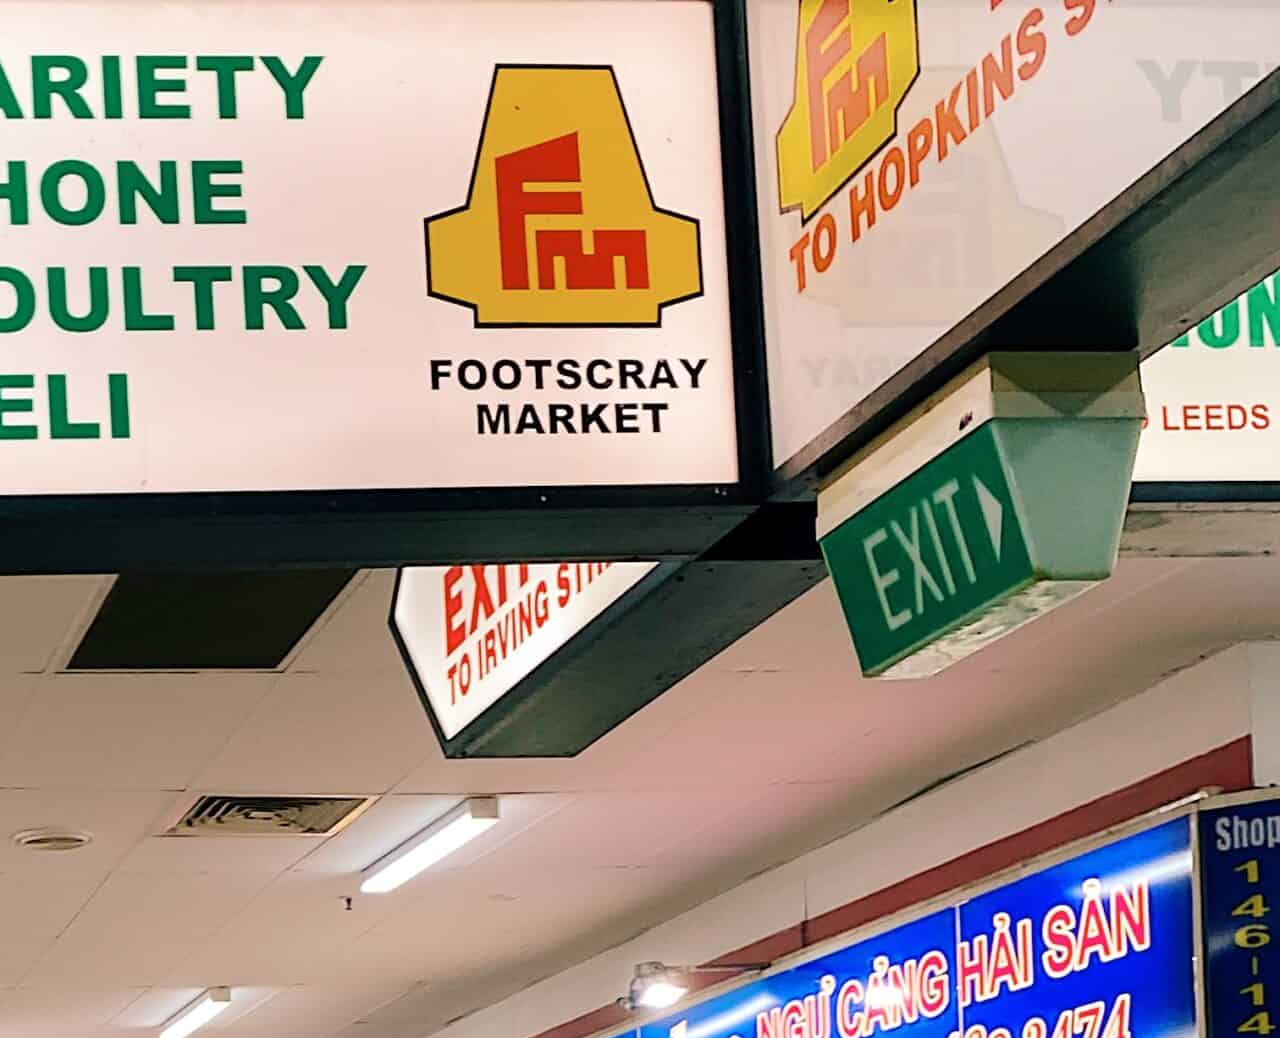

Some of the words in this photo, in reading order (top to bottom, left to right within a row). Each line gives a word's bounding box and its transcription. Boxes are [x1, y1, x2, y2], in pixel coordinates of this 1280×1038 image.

[789, 213, 837, 294] TO
[849, 8, 1047, 243] HOPKINS
[429, 358, 708, 391] FOOTSCRAY
[476, 403, 668, 435] MARKET
[1162, 404, 1270, 430] LEEDS
[863, 475, 978, 632] EXIT
[447, 653, 470, 705] TO
[478, 580, 549, 680] IRVING
[1215, 815, 1280, 851] Shop
[957, 912, 1035, 1008] HẢI
[1042, 878, 1151, 978] SẢN
